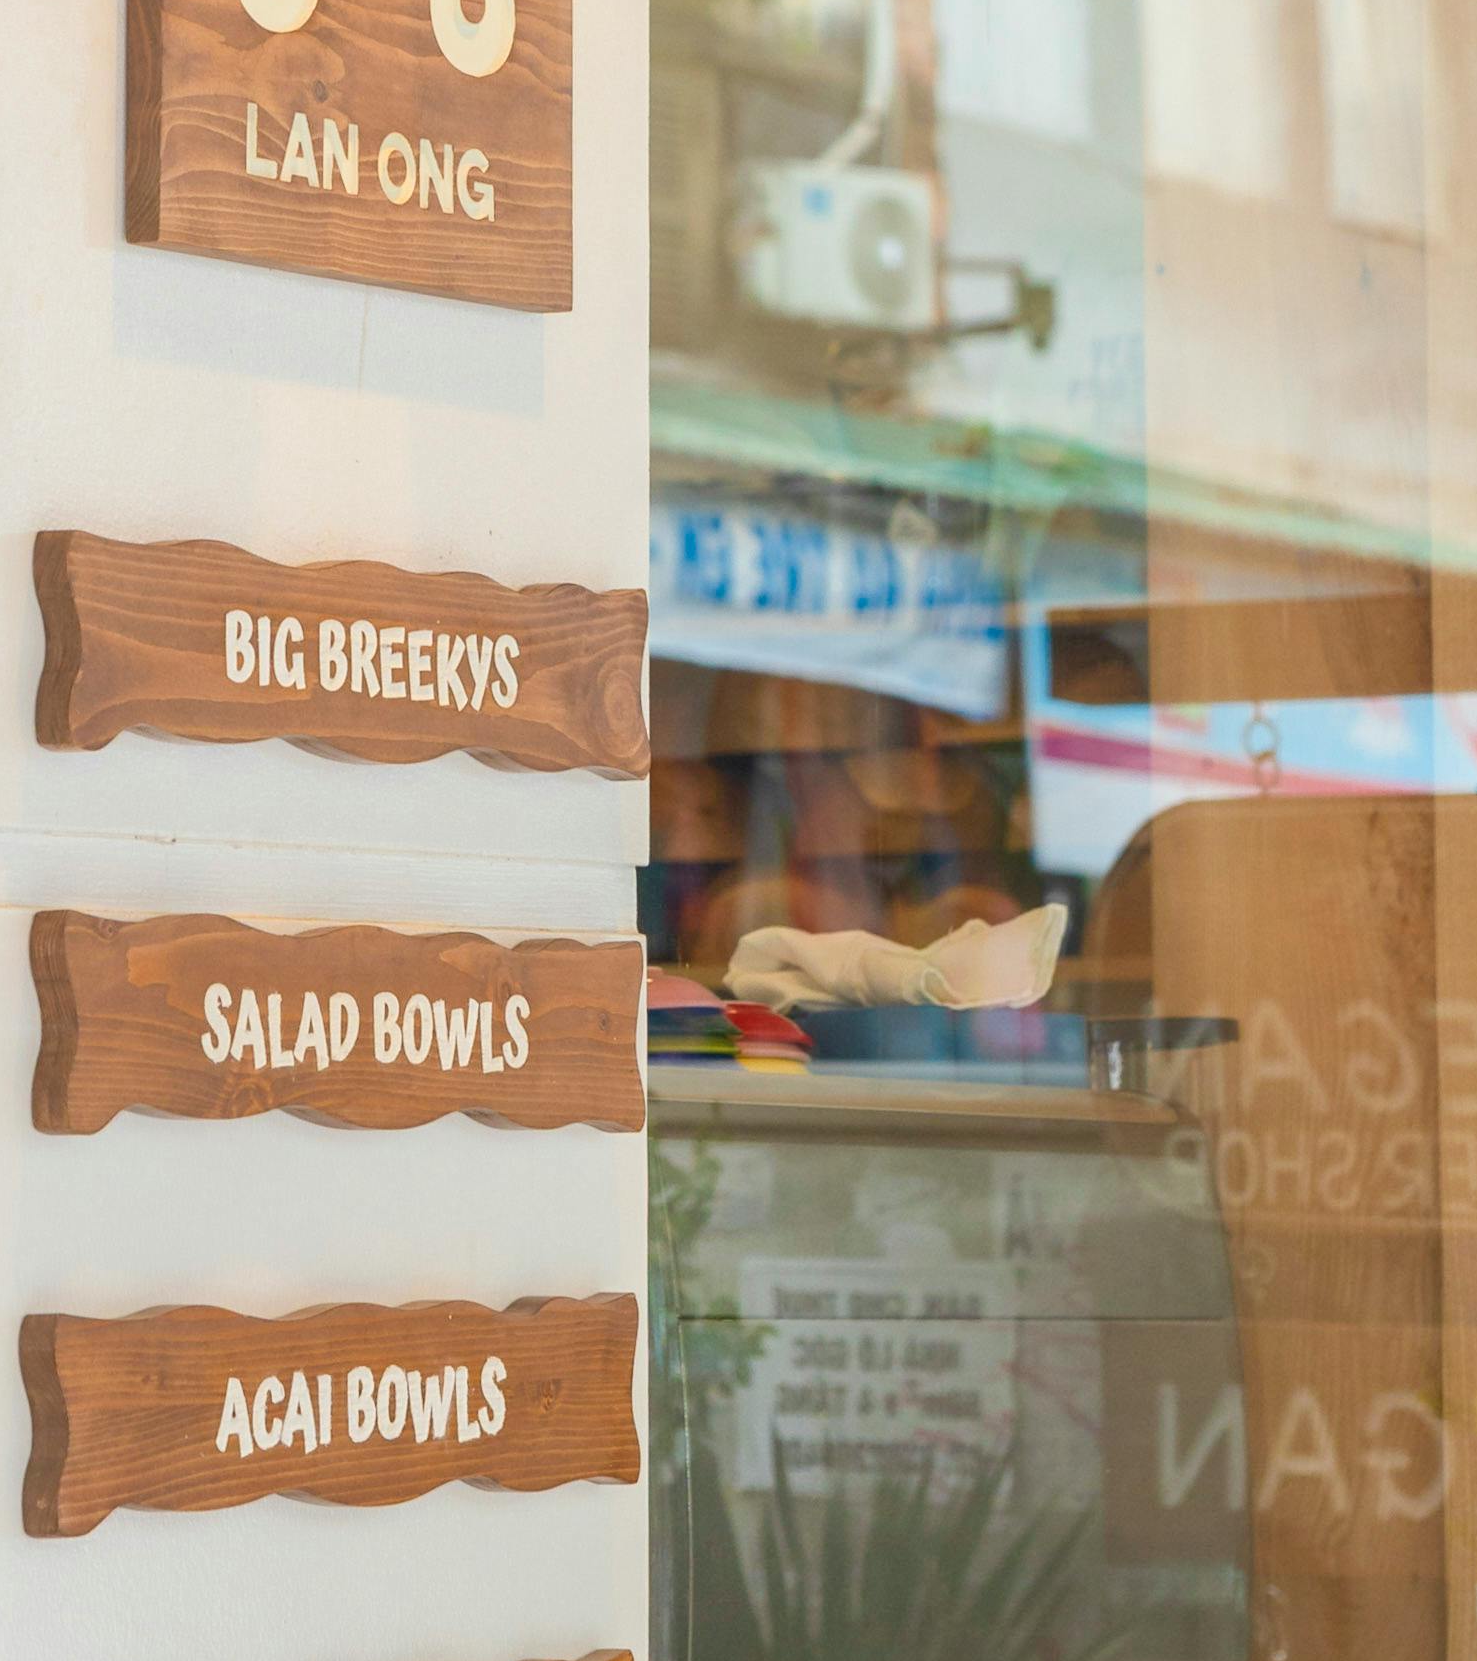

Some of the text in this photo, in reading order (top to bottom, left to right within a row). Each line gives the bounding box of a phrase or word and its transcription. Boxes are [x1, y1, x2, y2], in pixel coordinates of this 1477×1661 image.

[245, 101, 496, 223] LAN ONG
[225, 609, 520, 712] BIG BREEKYS
[201, 982, 531, 1074] SALAD BOWLS
[216, 1355, 508, 1458] ACAI BOWLS
